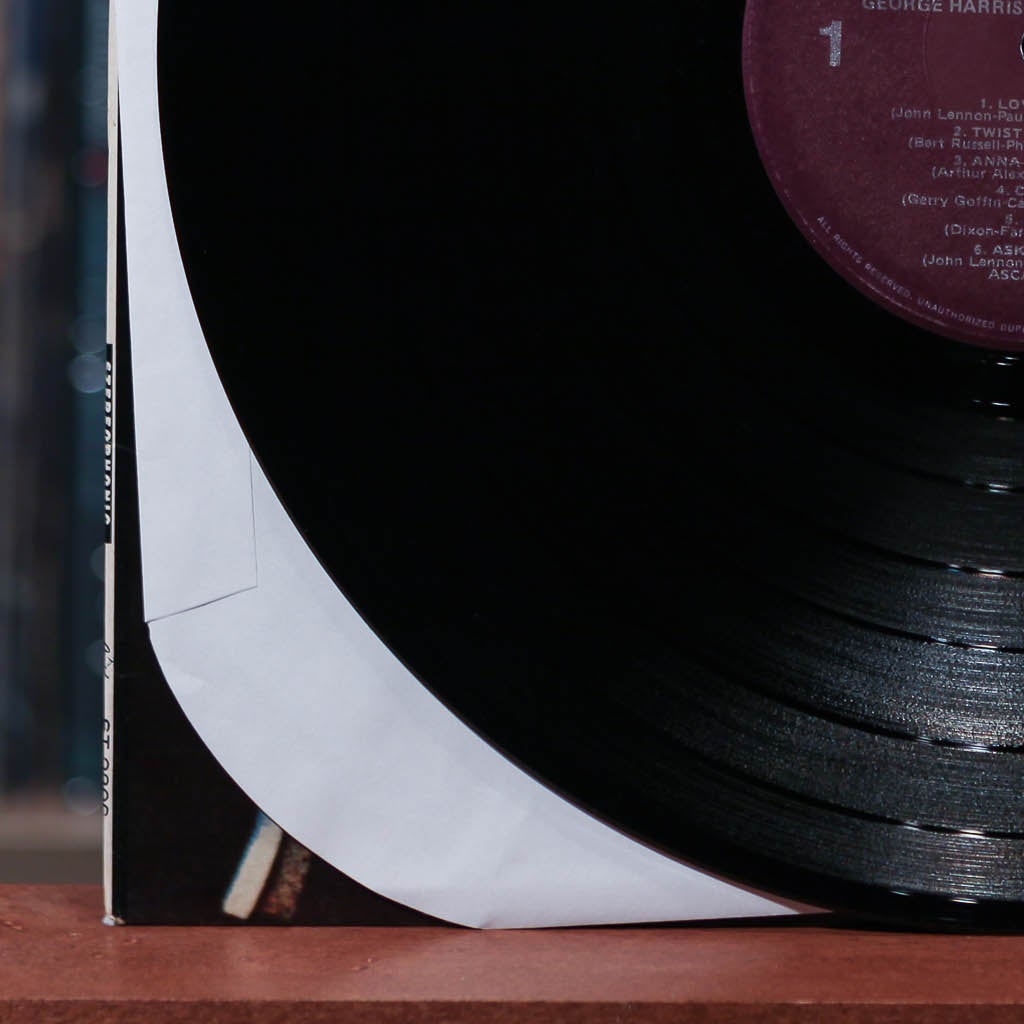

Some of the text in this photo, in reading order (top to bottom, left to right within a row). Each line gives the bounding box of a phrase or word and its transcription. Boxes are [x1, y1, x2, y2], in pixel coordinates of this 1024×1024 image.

[819, 20, 842, 67] 1
[980, 98, 993, 109] 1.
[891, 106, 932, 119] (John
[953, 126, 967, 137] 2.
[971, 126, 1022, 138] TWIST
[908, 136, 945, 150] (Bert
[972, 155, 1020, 167] ANNA
[931, 166, 986, 180] (Arthur
[996, 185, 1010, 195] 4.
[901, 192, 949, 208] (Gerry
[974, 244, 987, 255] 6.
[992, 245, 1024, 256] ASK
[922, 255, 963, 267] (John
[817, 216, 832, 234] ALL
[833, 233, 864, 264] RIGHTS
[917, 297, 996, 329] UNAUTHORIZED
